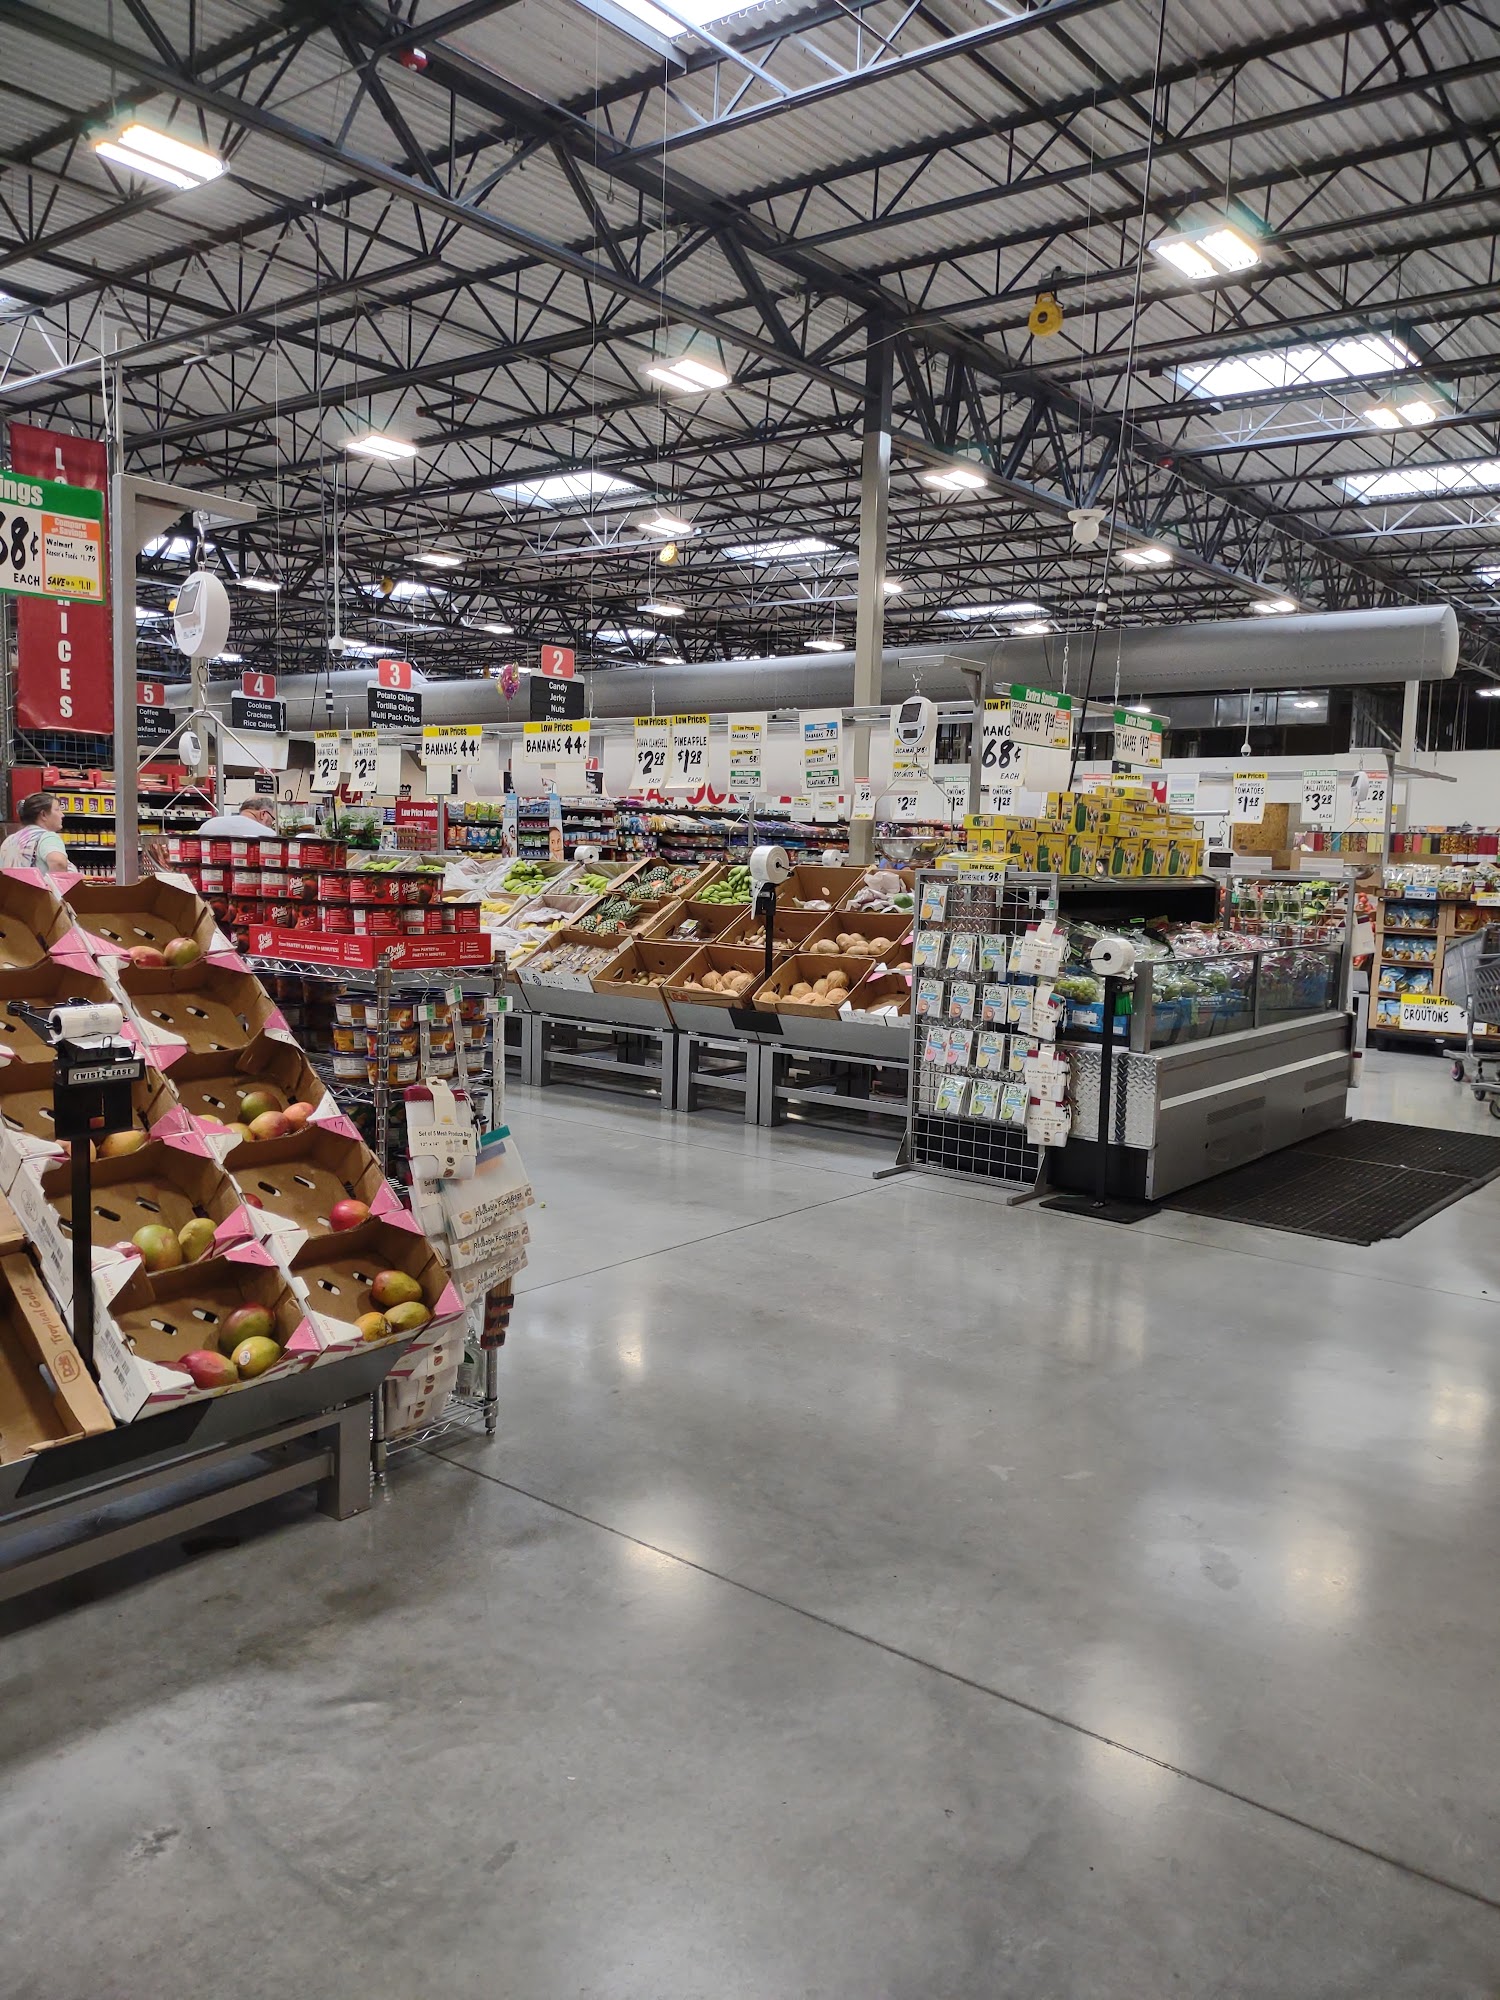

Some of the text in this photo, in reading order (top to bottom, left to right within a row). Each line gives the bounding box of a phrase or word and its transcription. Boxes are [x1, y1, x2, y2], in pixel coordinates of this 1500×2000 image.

[46, 538, 73, 549] Walmart
[13, 573, 40, 586] EACH
[47, 576, 65, 587] SAVE
[552, 650, 564, 675] 2
[389, 664, 401, 686] 3
[253, 676, 265, 696] 4
[548, 681, 568, 693] Candy
[143, 684, 155, 703] 5
[376, 691, 415, 702] Potato Chips
[550, 693, 566, 704] Jerky
[247, 701, 272, 711] Cookies
[376, 701, 415, 713] Tortilla Chips
[550, 704, 565, 713] Nuts
[984, 700, 1011, 710] Low Pri
[139, 708, 159, 716] Coffee
[246, 711, 273, 720] Crackers
[371, 711, 420, 723] Multi Pack Chips
[257, 721, 277, 729] Cakes
[637, 718, 667, 726] Low Prices
[675, 716, 707, 724] Low Prices
[438, 727, 467, 736] Low Prices
[541, 722, 573, 732] Low Prices
[983, 725, 1010, 736] MANG
[526, 738, 561, 753] BANANAS
[674, 736, 707, 746] PINEAPPLE
[425, 741, 457, 756] BANANAS
[981, 739, 1022, 769] 68¢
[1000, 772, 1020, 780] EACH
[1234, 787, 1265, 795] TOMATOES
[401, 808, 410, 817] Low
[411, 808, 423, 817] Price
[1423, 997, 1438, 1005] Low
[1403, 1009, 1449, 1024] CROUTONS
[75, 1071, 101, 1081] TWIST
[112, 1068, 132, 1076] EASE
[475, 1192, 523, 1218] Reusable Food Bags
[474, 1229, 520, 1249] Reusable Food Bags
[20, 1286, 64, 1345] Tropical Gold
